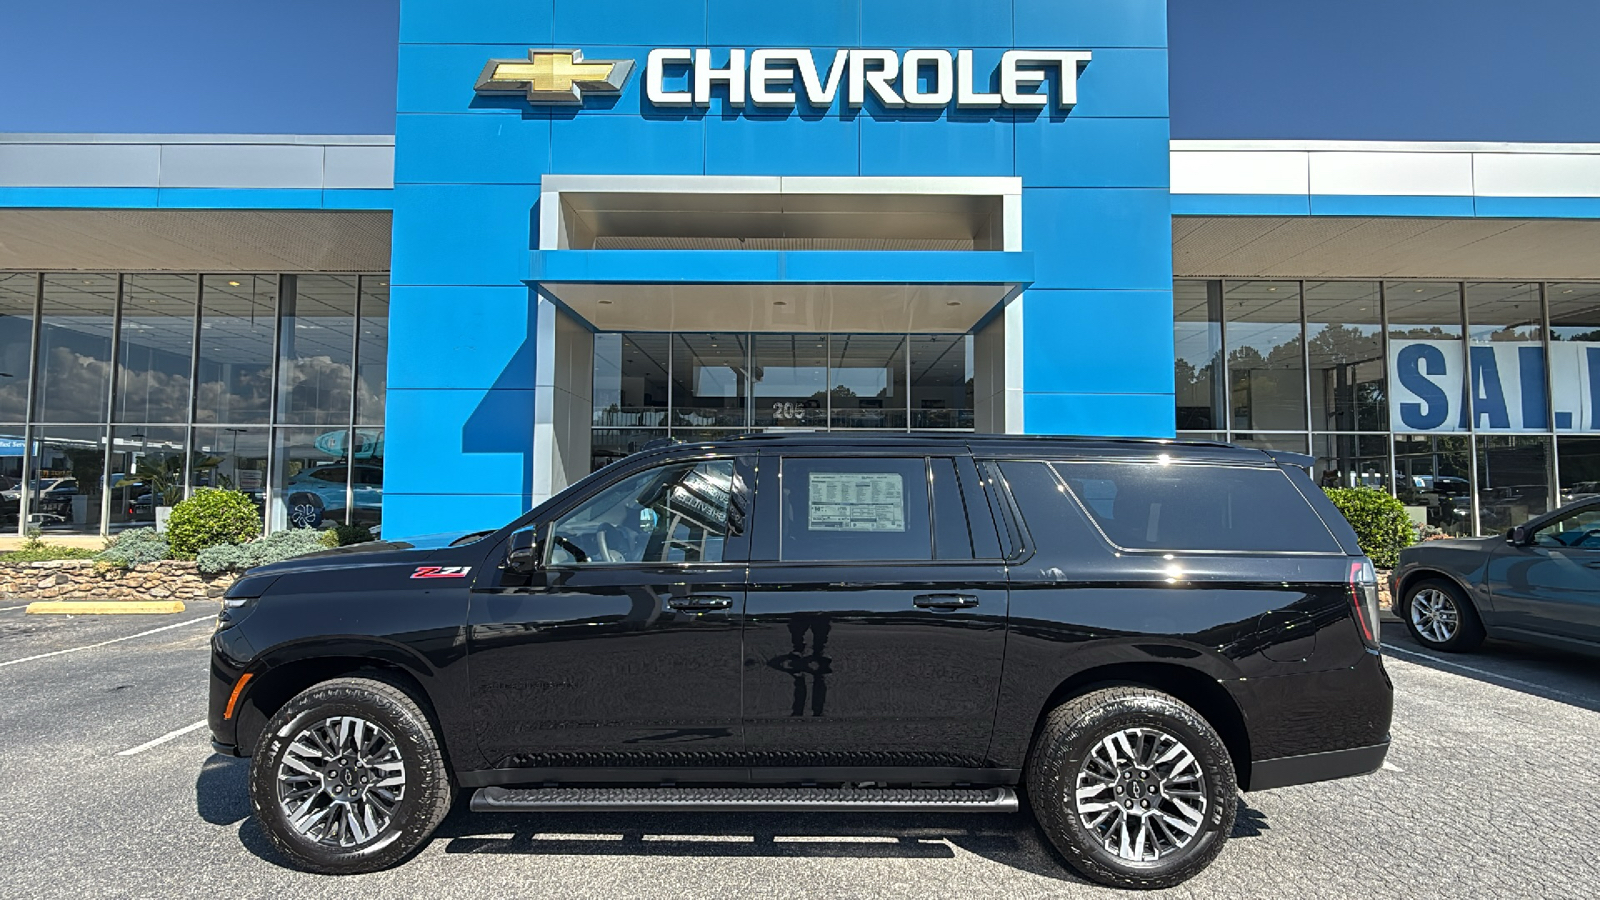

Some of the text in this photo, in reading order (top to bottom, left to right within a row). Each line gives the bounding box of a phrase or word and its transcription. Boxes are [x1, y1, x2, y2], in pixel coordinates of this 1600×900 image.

[646, 48, 1092, 109] CHEVROLET
[1396, 343, 1600, 430] SAL
[410, 566, 472, 579] Z71
